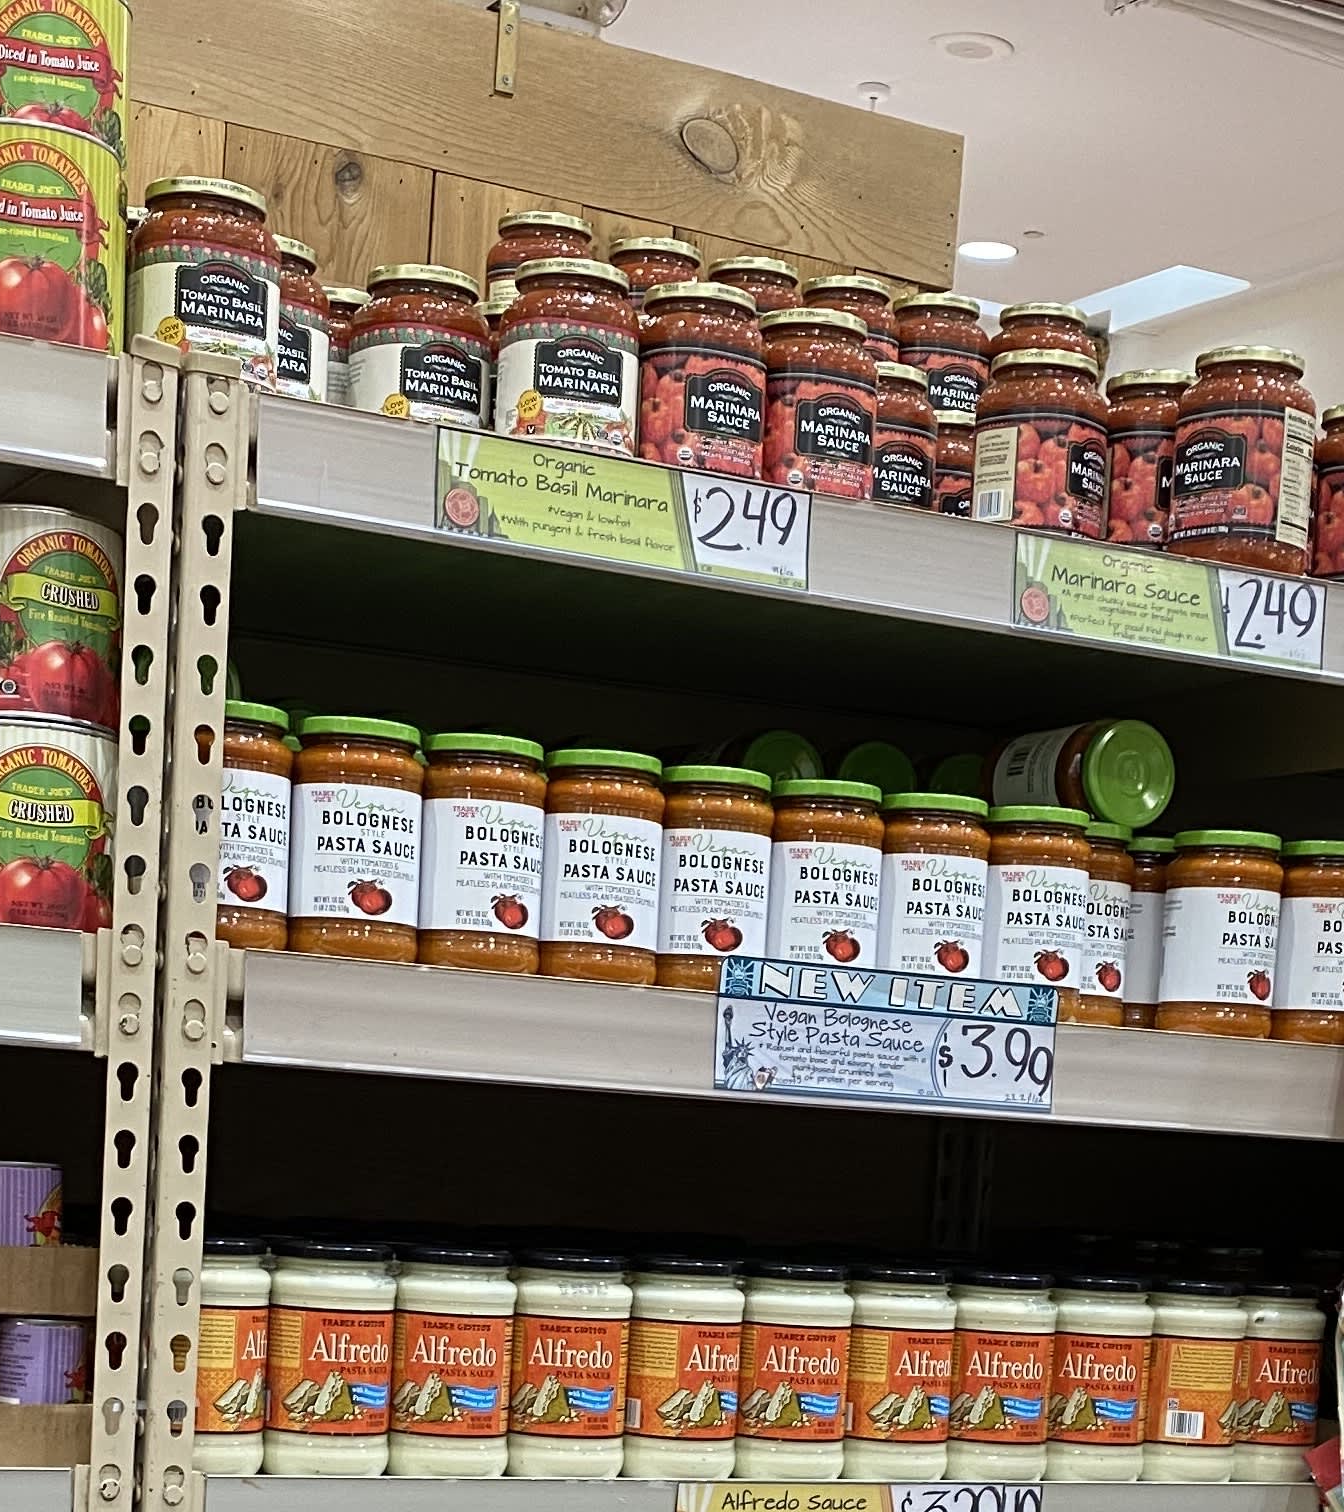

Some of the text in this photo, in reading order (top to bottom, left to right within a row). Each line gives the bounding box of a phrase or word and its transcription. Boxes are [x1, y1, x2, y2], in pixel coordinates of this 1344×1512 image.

[199, 273, 251, 295] ORGANIC
[180, 300, 265, 330] MARINARA
[181, 289, 265, 315] TOMATO BASIL
[533, 453, 596, 478] Organic
[455, 463, 669, 513] Tomato Basil Marinara
[694, 487, 797, 551] $2.49
[1103, 555, 1155, 577] Organic
[1051, 566, 1201, 606] Marinara Sauce
[336, 785, 405, 815] Vegan
[322, 810, 414, 835] BOLOGNESE
[317, 835, 415, 860] PASTA SAUCE
[759, 962, 1023, 1018] NEW ITEM
[764, 1004, 913, 1034] Vegan Bolognese
[750, 1022, 925, 1053] Style Pasta Sauce
[939, 1024, 1054, 1096] $3.99
[529, 1337, 614, 1369] Alfredo
[721, 1490, 867, 1511] Alfredo Sauce
